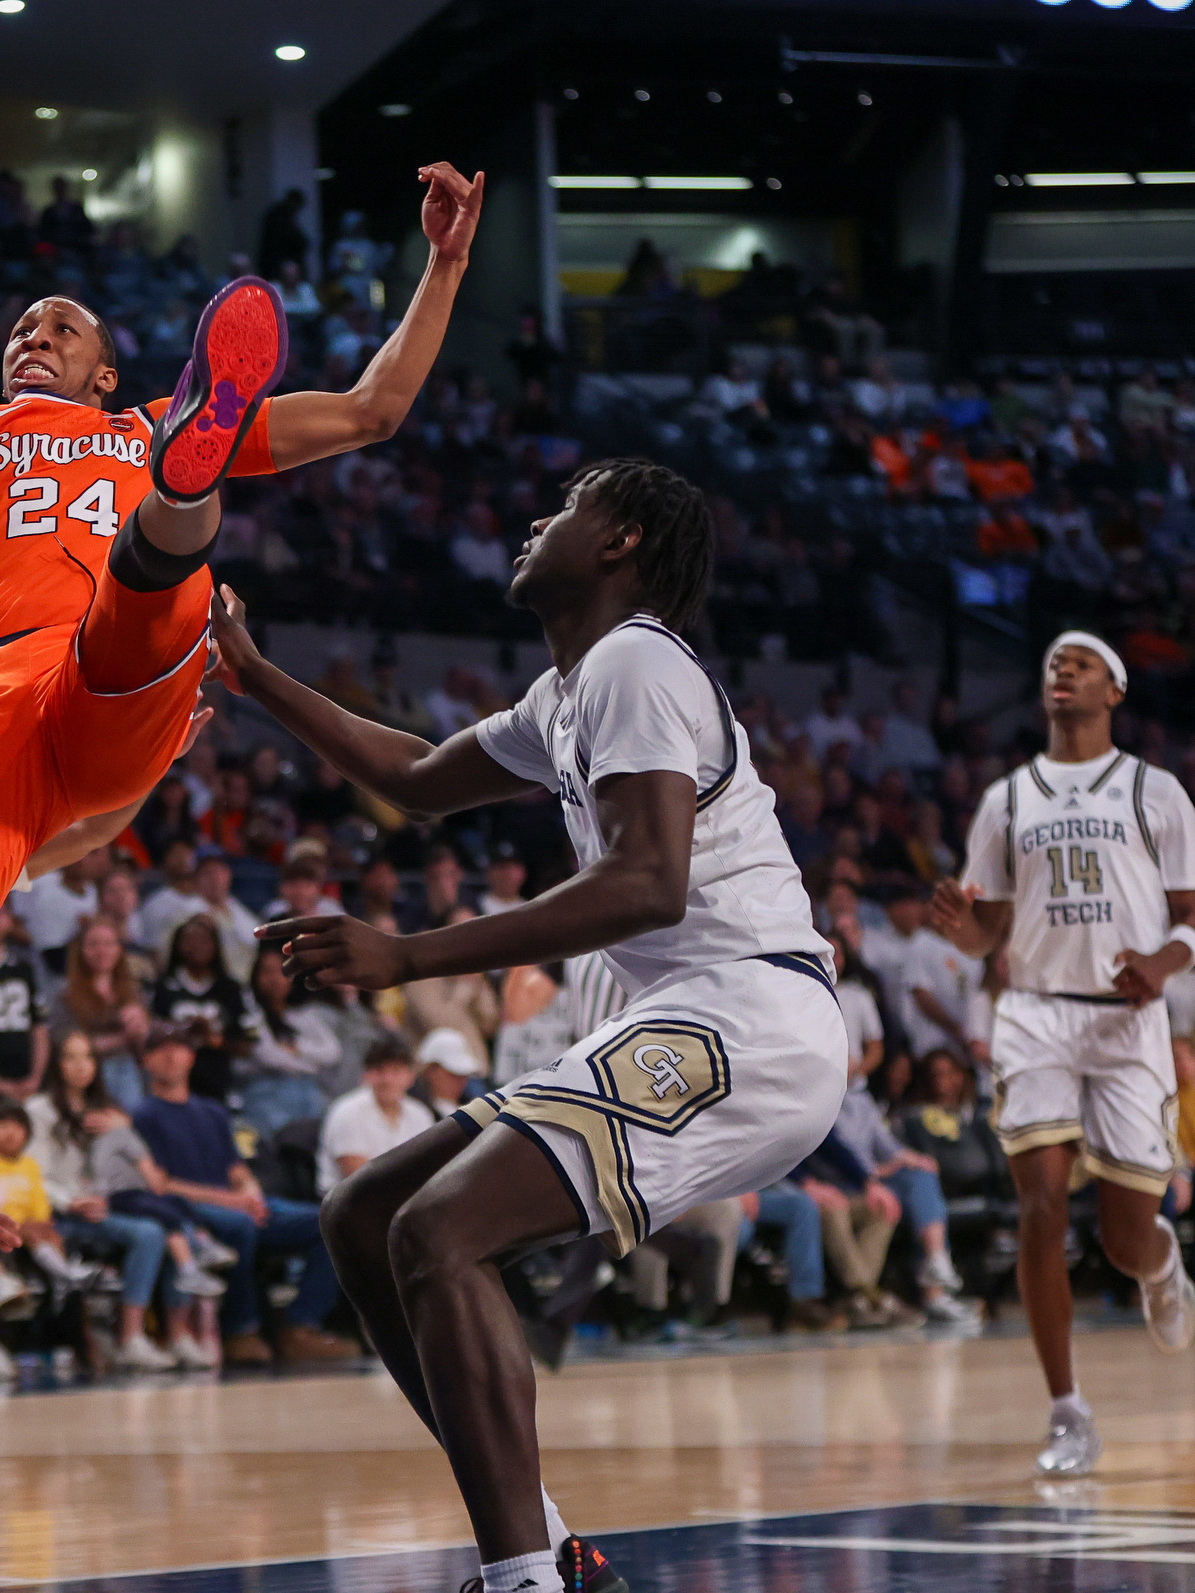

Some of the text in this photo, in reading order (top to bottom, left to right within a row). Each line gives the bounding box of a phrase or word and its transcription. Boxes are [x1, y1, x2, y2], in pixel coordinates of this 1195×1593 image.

[7, 477, 119, 539] 24
[1019, 817, 1128, 856] GEORGIA
[1047, 845, 1103, 898] 14
[1046, 901, 1114, 928] TECH
